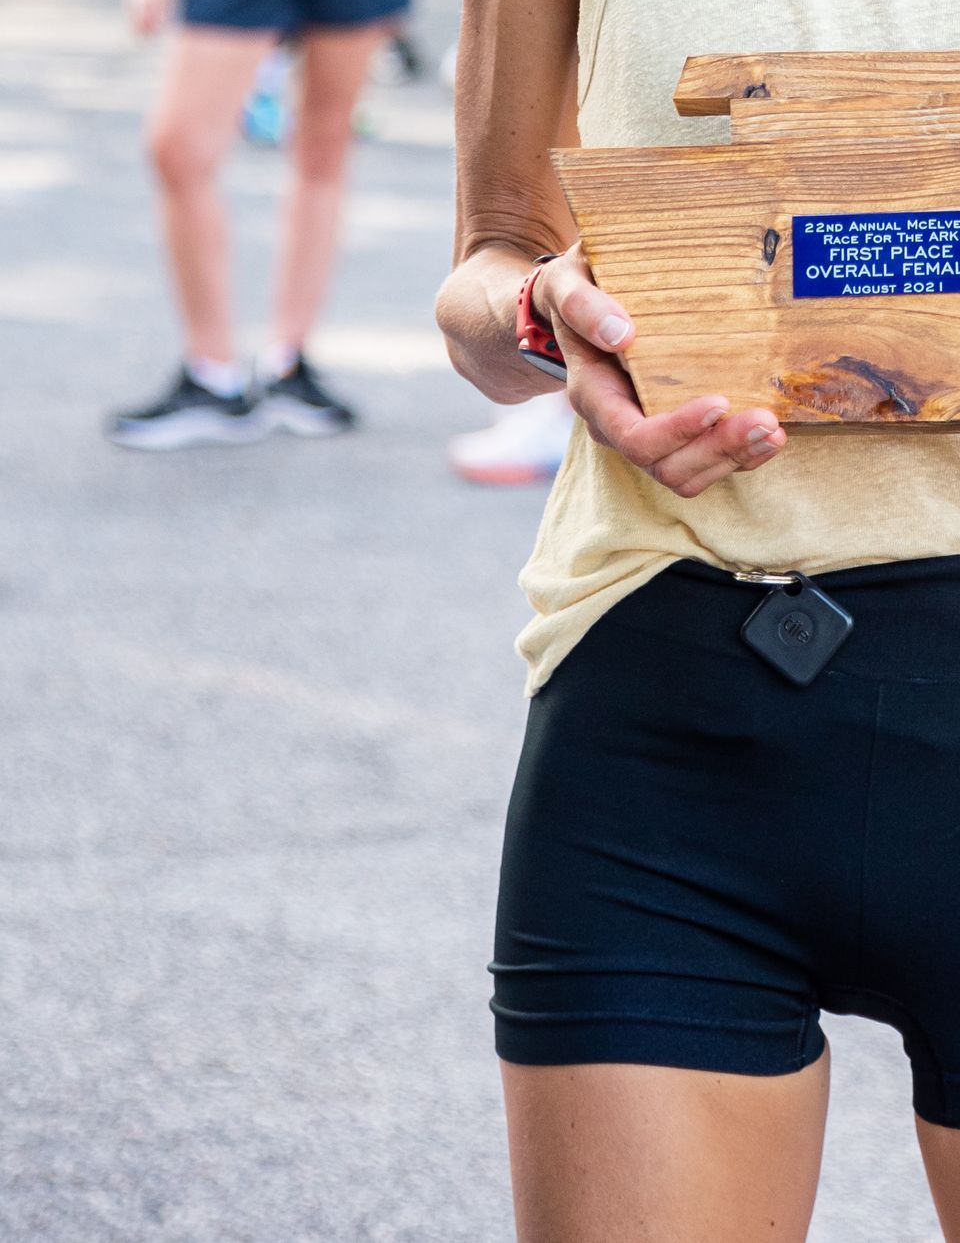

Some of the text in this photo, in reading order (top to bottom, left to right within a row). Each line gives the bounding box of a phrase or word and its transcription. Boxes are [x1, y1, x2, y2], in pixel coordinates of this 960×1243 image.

[929, 231, 959, 242] ARK
[830, 245, 953, 261] FIRST PLACE
[806, 263, 894, 279] OVERALL
[903, 282, 943, 293] 2021
